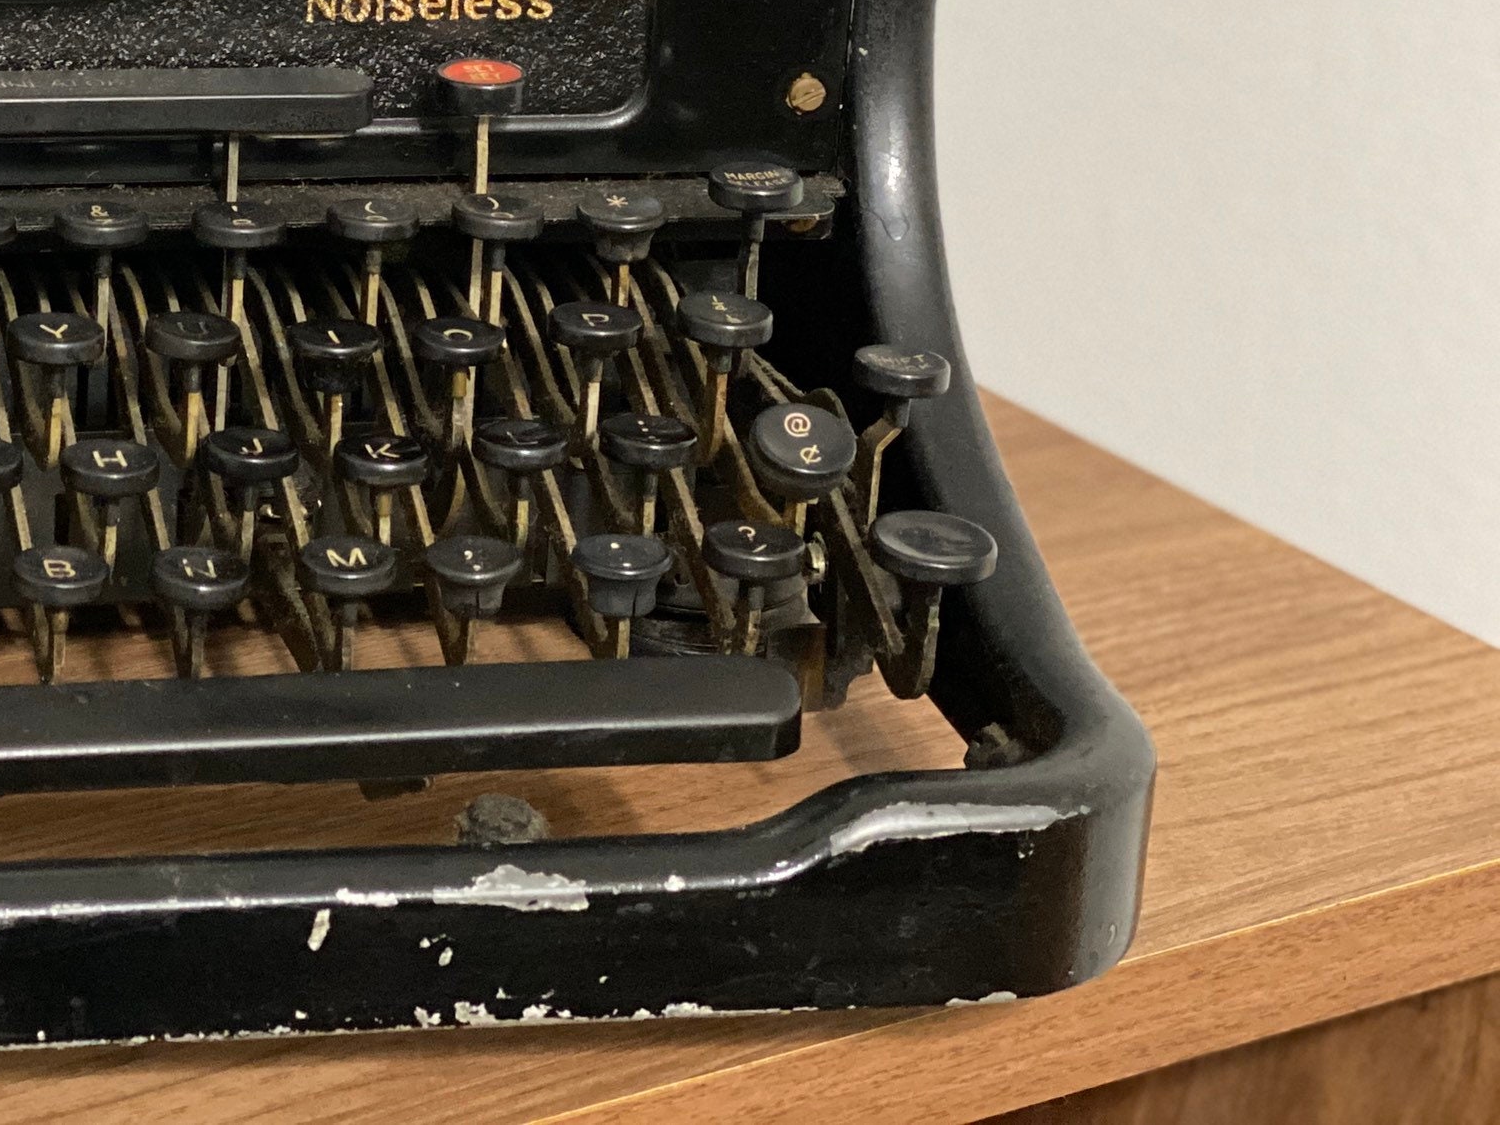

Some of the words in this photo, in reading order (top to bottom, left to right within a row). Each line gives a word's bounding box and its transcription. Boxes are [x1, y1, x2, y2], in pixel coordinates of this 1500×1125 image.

[90, 204, 110, 218] &
[39, 322, 68, 339] Y
[783, 412, 811, 436] @
[92, 450, 128, 467] H
[364, 443, 400, 458] K
[325, 547, 368, 568] M
[42, 558, 76, 579] B
